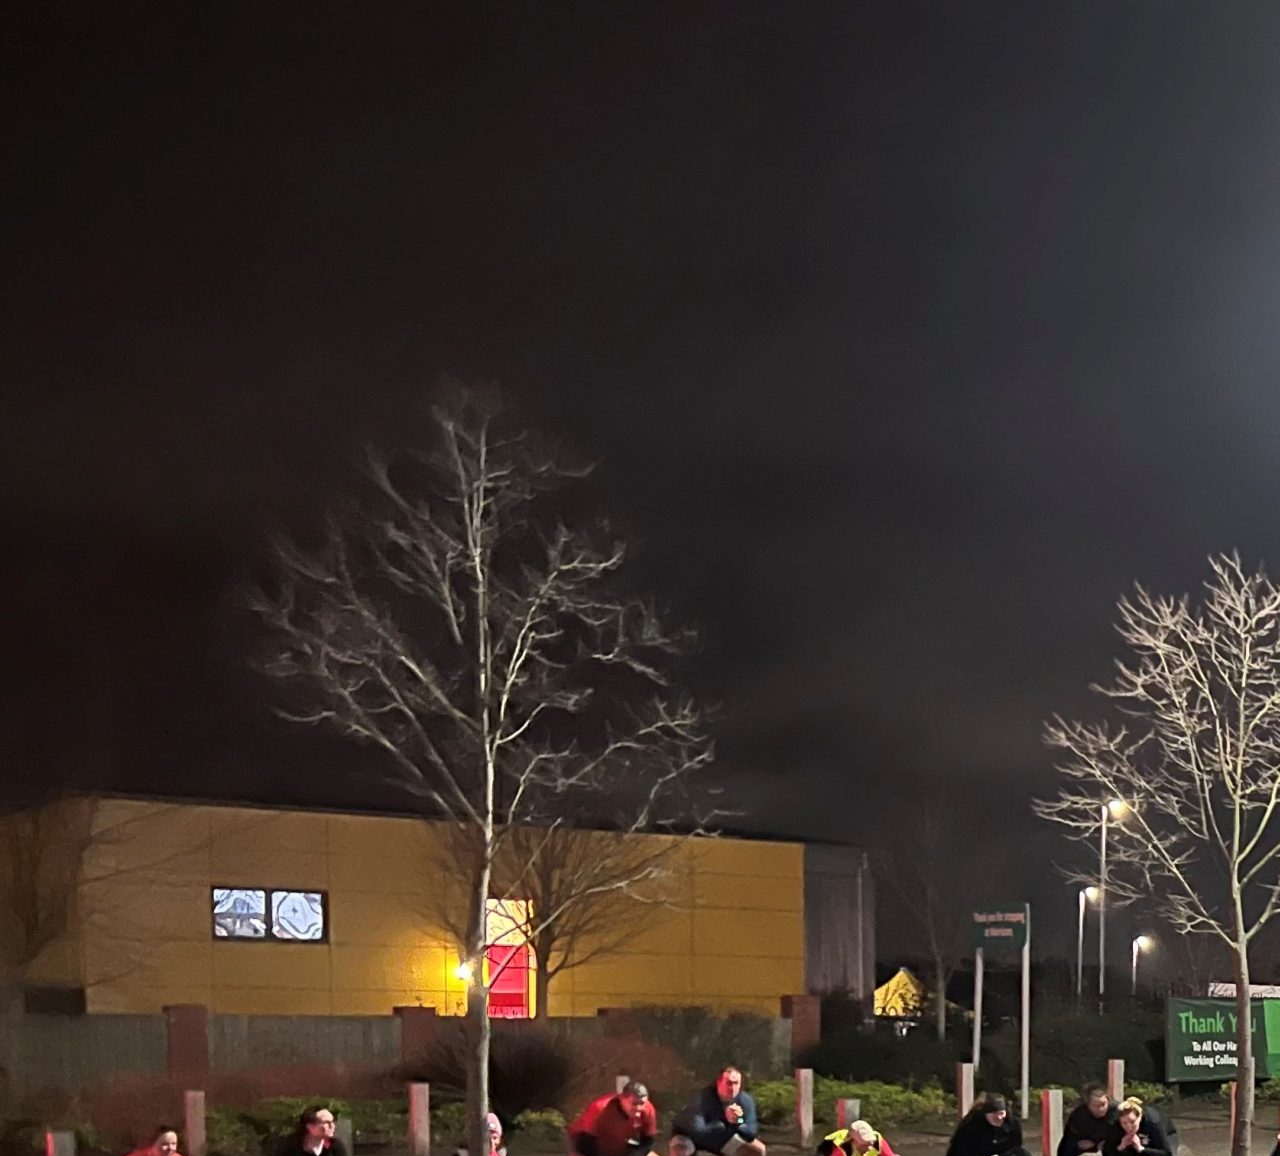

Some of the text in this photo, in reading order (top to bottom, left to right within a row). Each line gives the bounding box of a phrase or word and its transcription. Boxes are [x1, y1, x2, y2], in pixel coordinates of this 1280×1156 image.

[1178, 1011, 1256, 1033] Thank Yu
[1192, 1041, 1201, 1052] To
[1202, 1041, 1212, 1052] All
[1213, 1041, 1226, 1052] Our
[1184, 1055, 1214, 1068] Working
